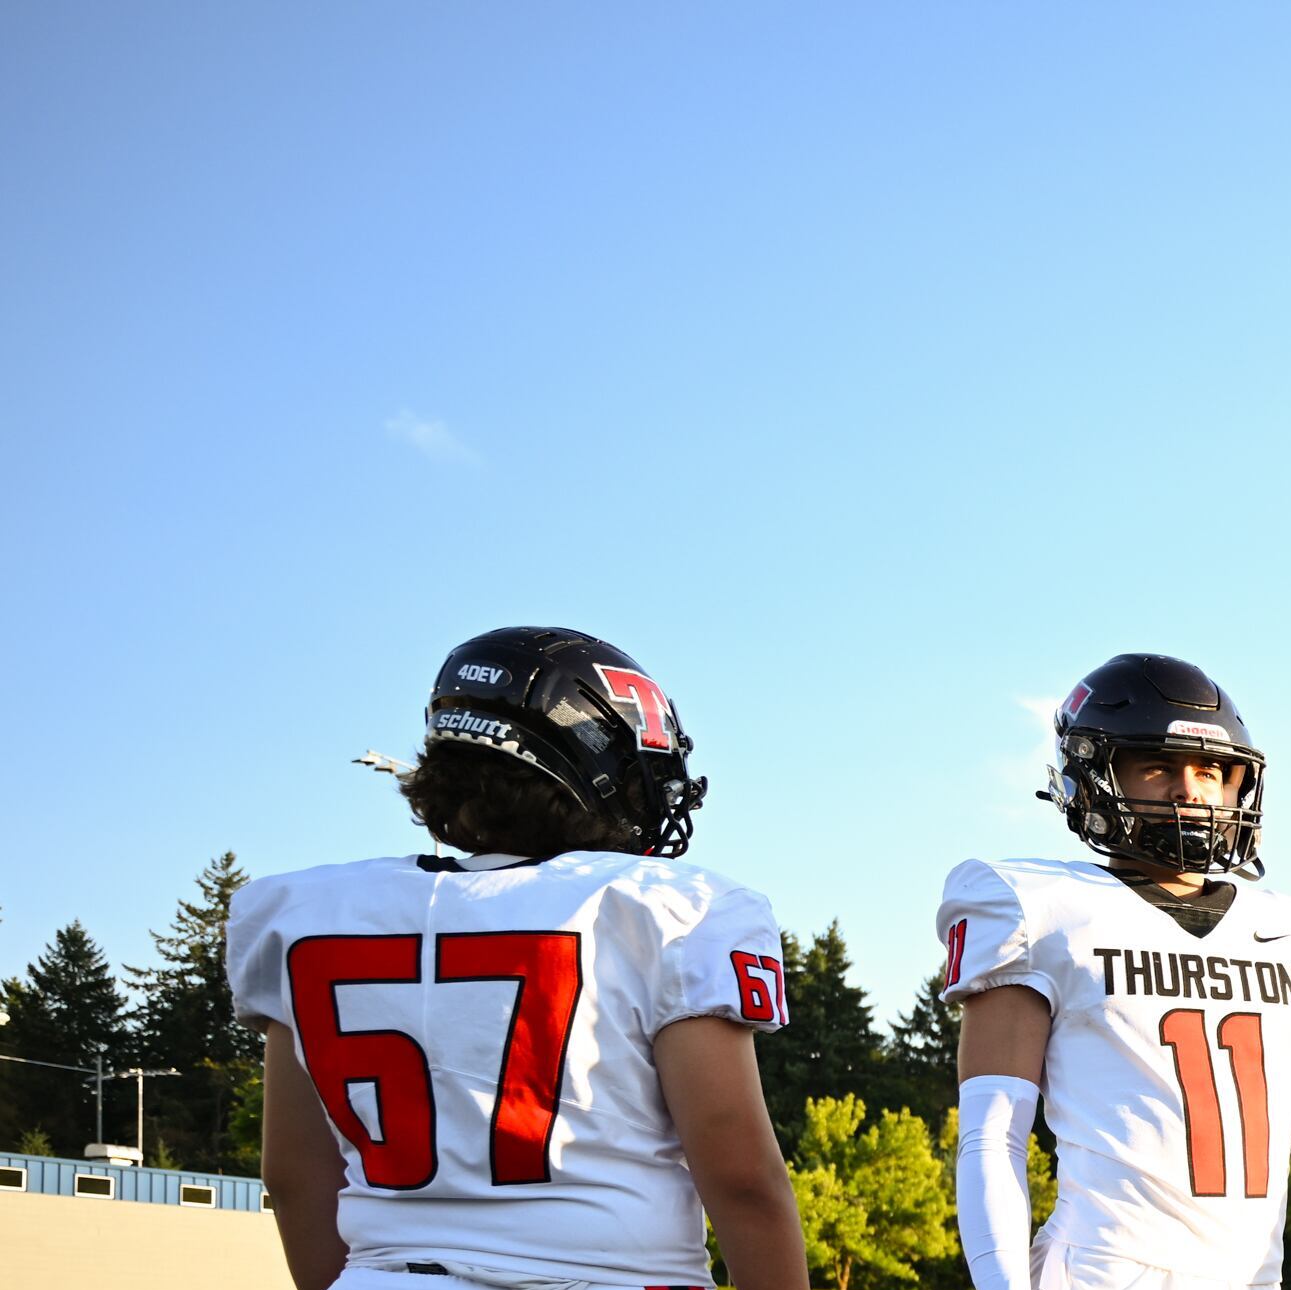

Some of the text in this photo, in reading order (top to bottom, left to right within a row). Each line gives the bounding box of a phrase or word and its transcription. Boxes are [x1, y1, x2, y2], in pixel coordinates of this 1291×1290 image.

[457, 664, 504, 685] 4DEV
[594, 662, 673, 754] T
[436, 710, 513, 739] schutt
[729, 949, 787, 1026] 67
[286, 930, 582, 1190] 67
[1159, 1007, 1269, 1199] 11
